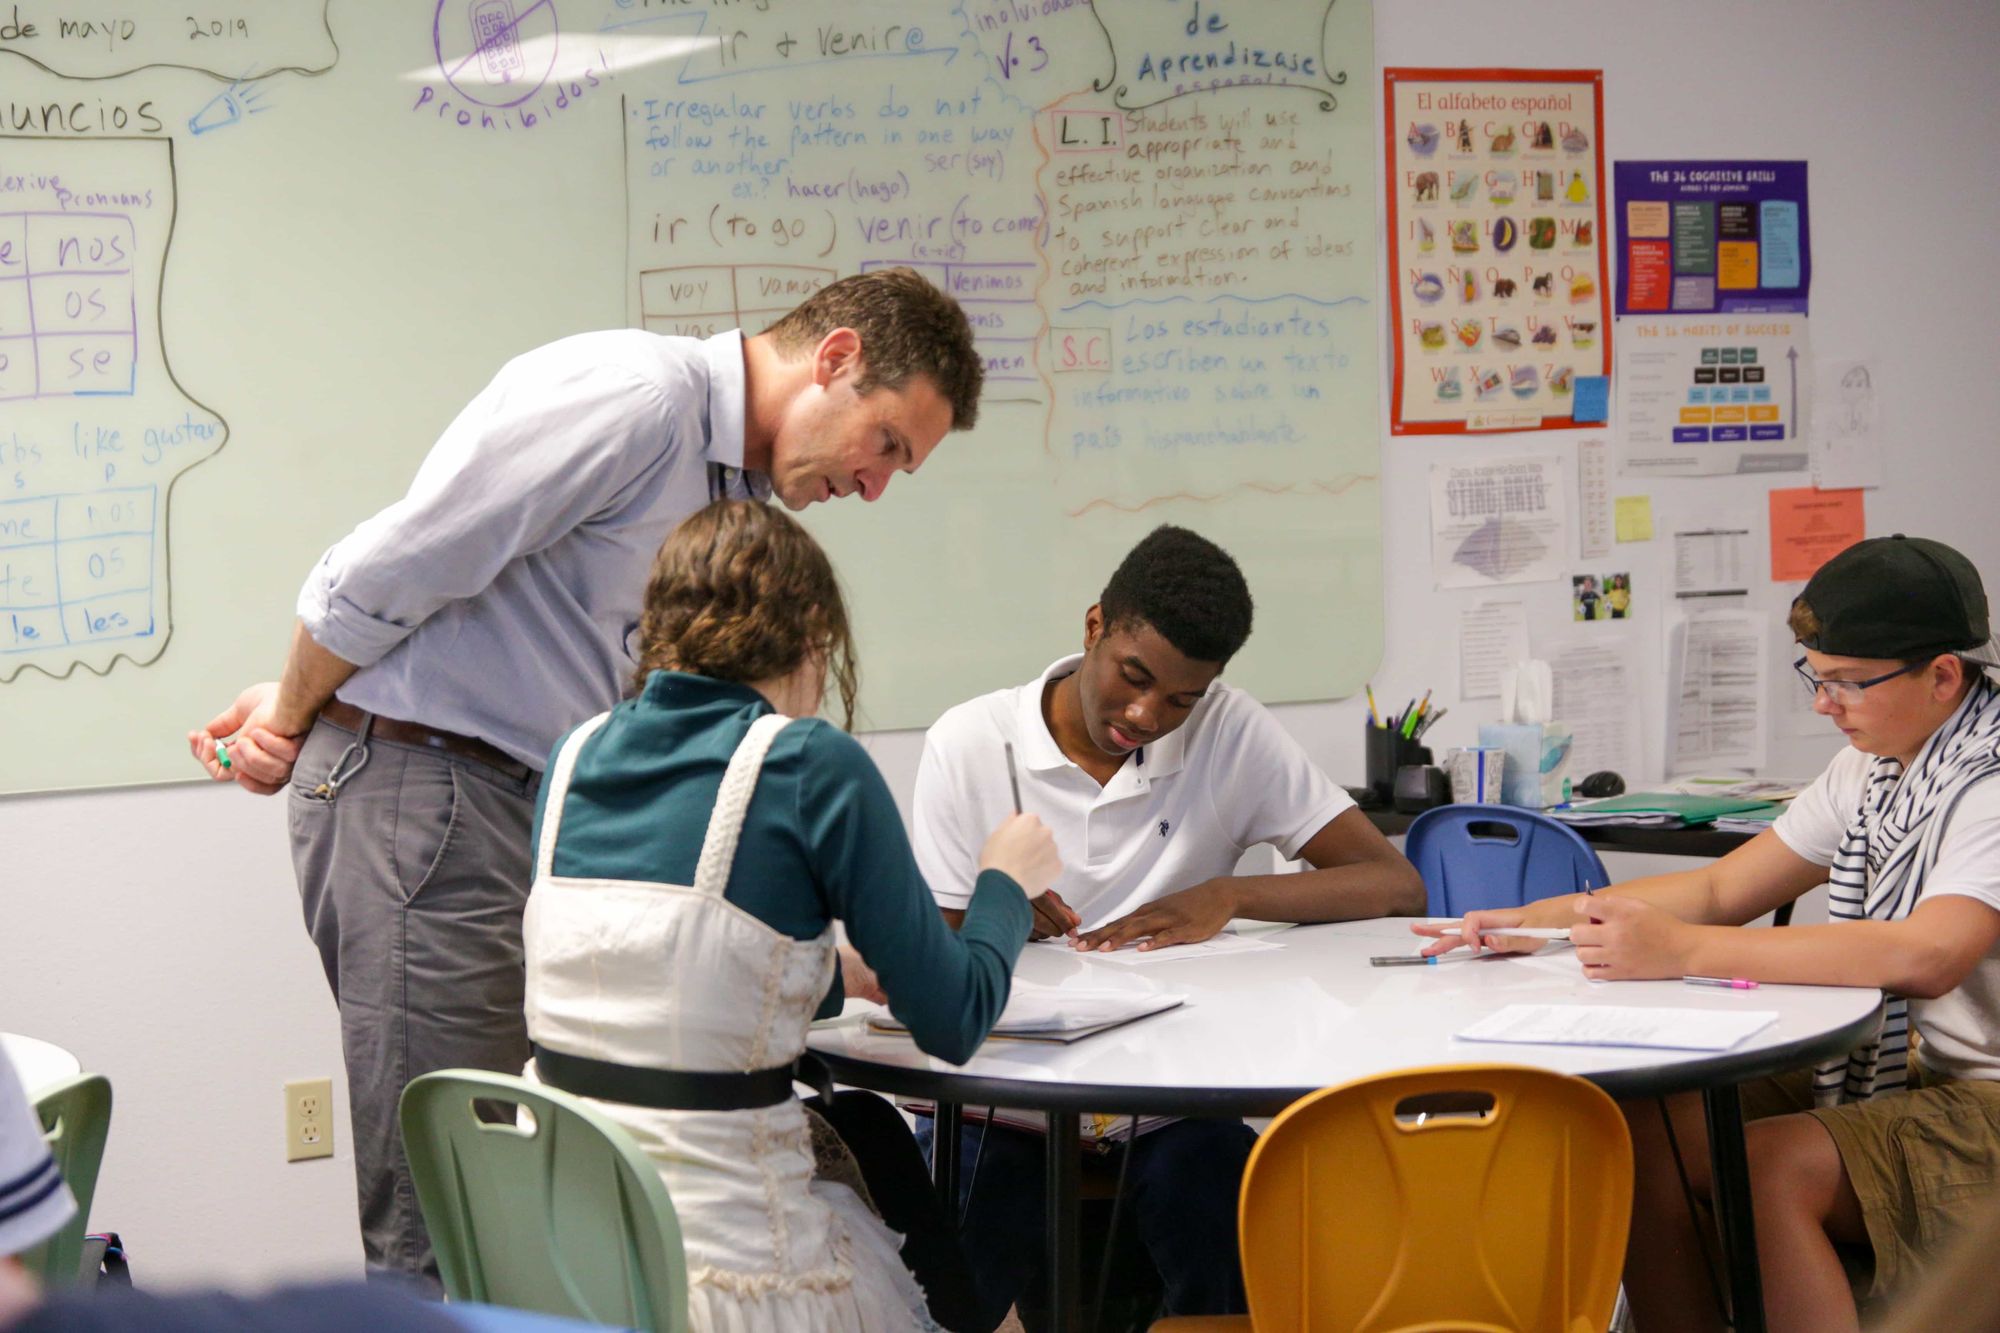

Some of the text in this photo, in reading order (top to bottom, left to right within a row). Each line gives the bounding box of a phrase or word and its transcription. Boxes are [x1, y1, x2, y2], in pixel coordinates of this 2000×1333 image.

[0, 4, 249, 52] de mayo 2019
[1185, 0, 1229, 37] de
[1137, 41, 1316, 82] Aprendizaje
[644, 92, 767, 127] Irregular
[877, 84, 911, 118] do
[935, 86, 983, 117] not
[1265, 111, 1300, 126] use
[1417, 92, 1573, 116] El alfabeto español
[645, 121, 1016, 158] follow the pattern in one way
[1259, 127, 1298, 150] and
[650, 157, 676, 178] or
[1056, 158, 1143, 187] effective
[1289, 147, 1333, 176] and
[1058, 186, 1142, 222] Spanish
[653, 212, 688, 244] ir
[1055, 226, 1080, 252] to
[1101, 214, 1187, 256] support
[1264, 205, 1299, 229] and
[59, 235, 126, 267] nos
[1270, 239, 1291, 260] of
[669, 280, 709, 309] voy
[1069, 275, 1107, 297] and
[65, 288, 107, 322] os
[1182, 306, 1330, 338] estudiantes
[67, 348, 111, 379] se
[72, 420, 125, 460] like
[142, 411, 222, 466] gustar
[12, 613, 41, 645] le
[83, 606, 130, 635] les
